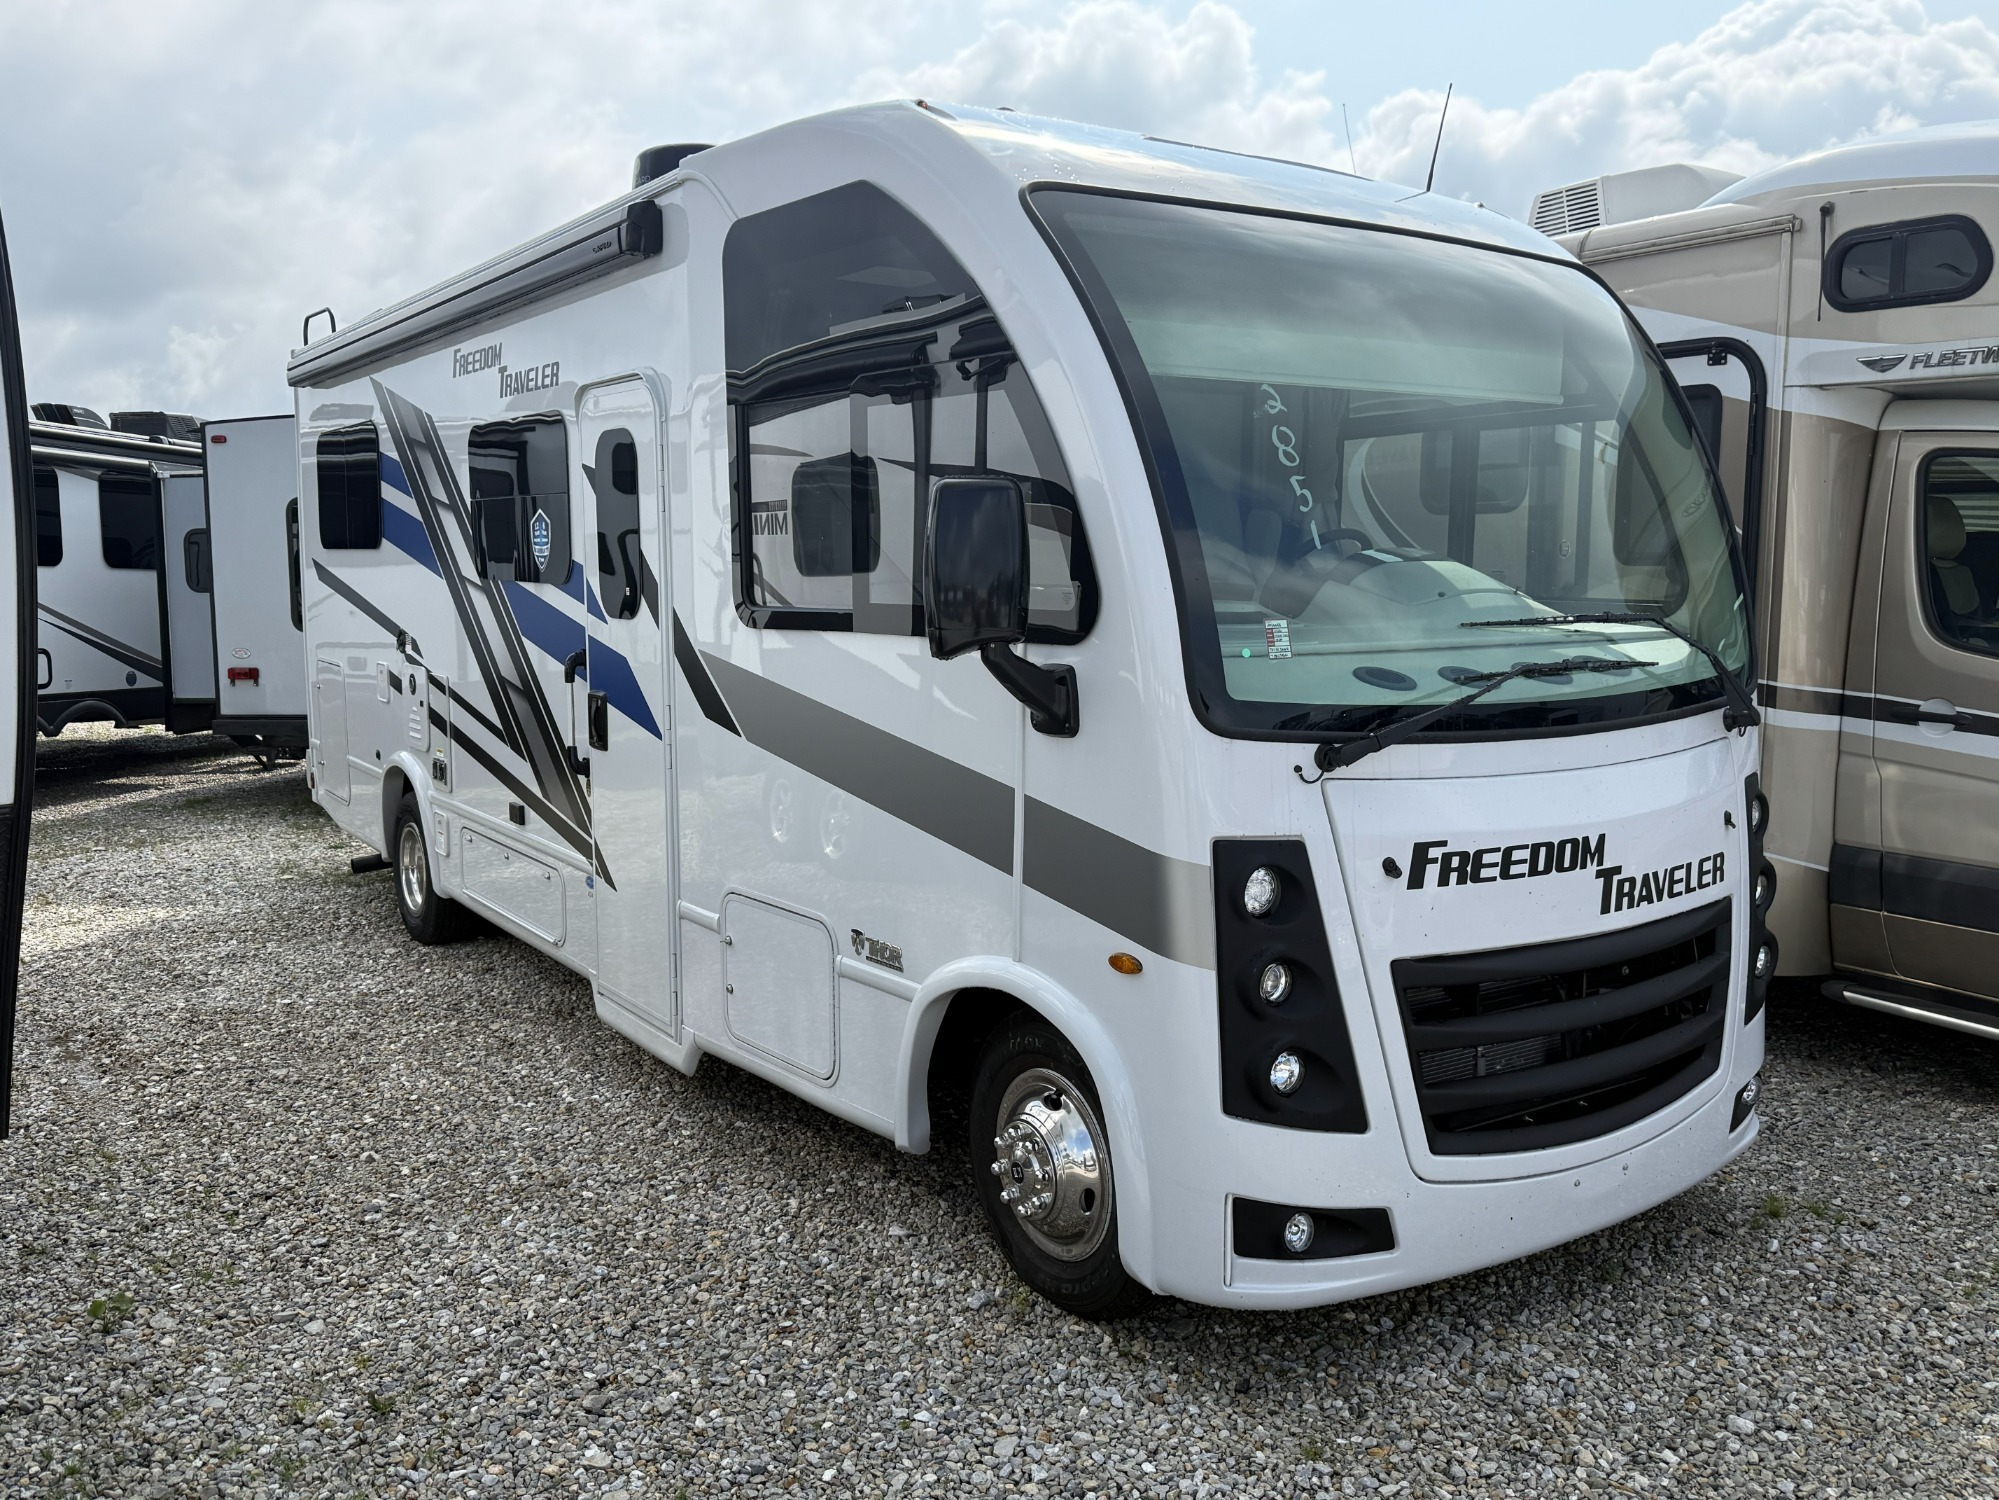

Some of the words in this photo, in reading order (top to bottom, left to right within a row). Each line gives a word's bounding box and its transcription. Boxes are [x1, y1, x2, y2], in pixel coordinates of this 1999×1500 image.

[453, 342, 502, 378] FREEDOM
[498, 361, 559, 398] TRAVELER
[1406, 833, 1606, 890] FREEDOM
[1595, 851, 1725, 915] TRAVELER
